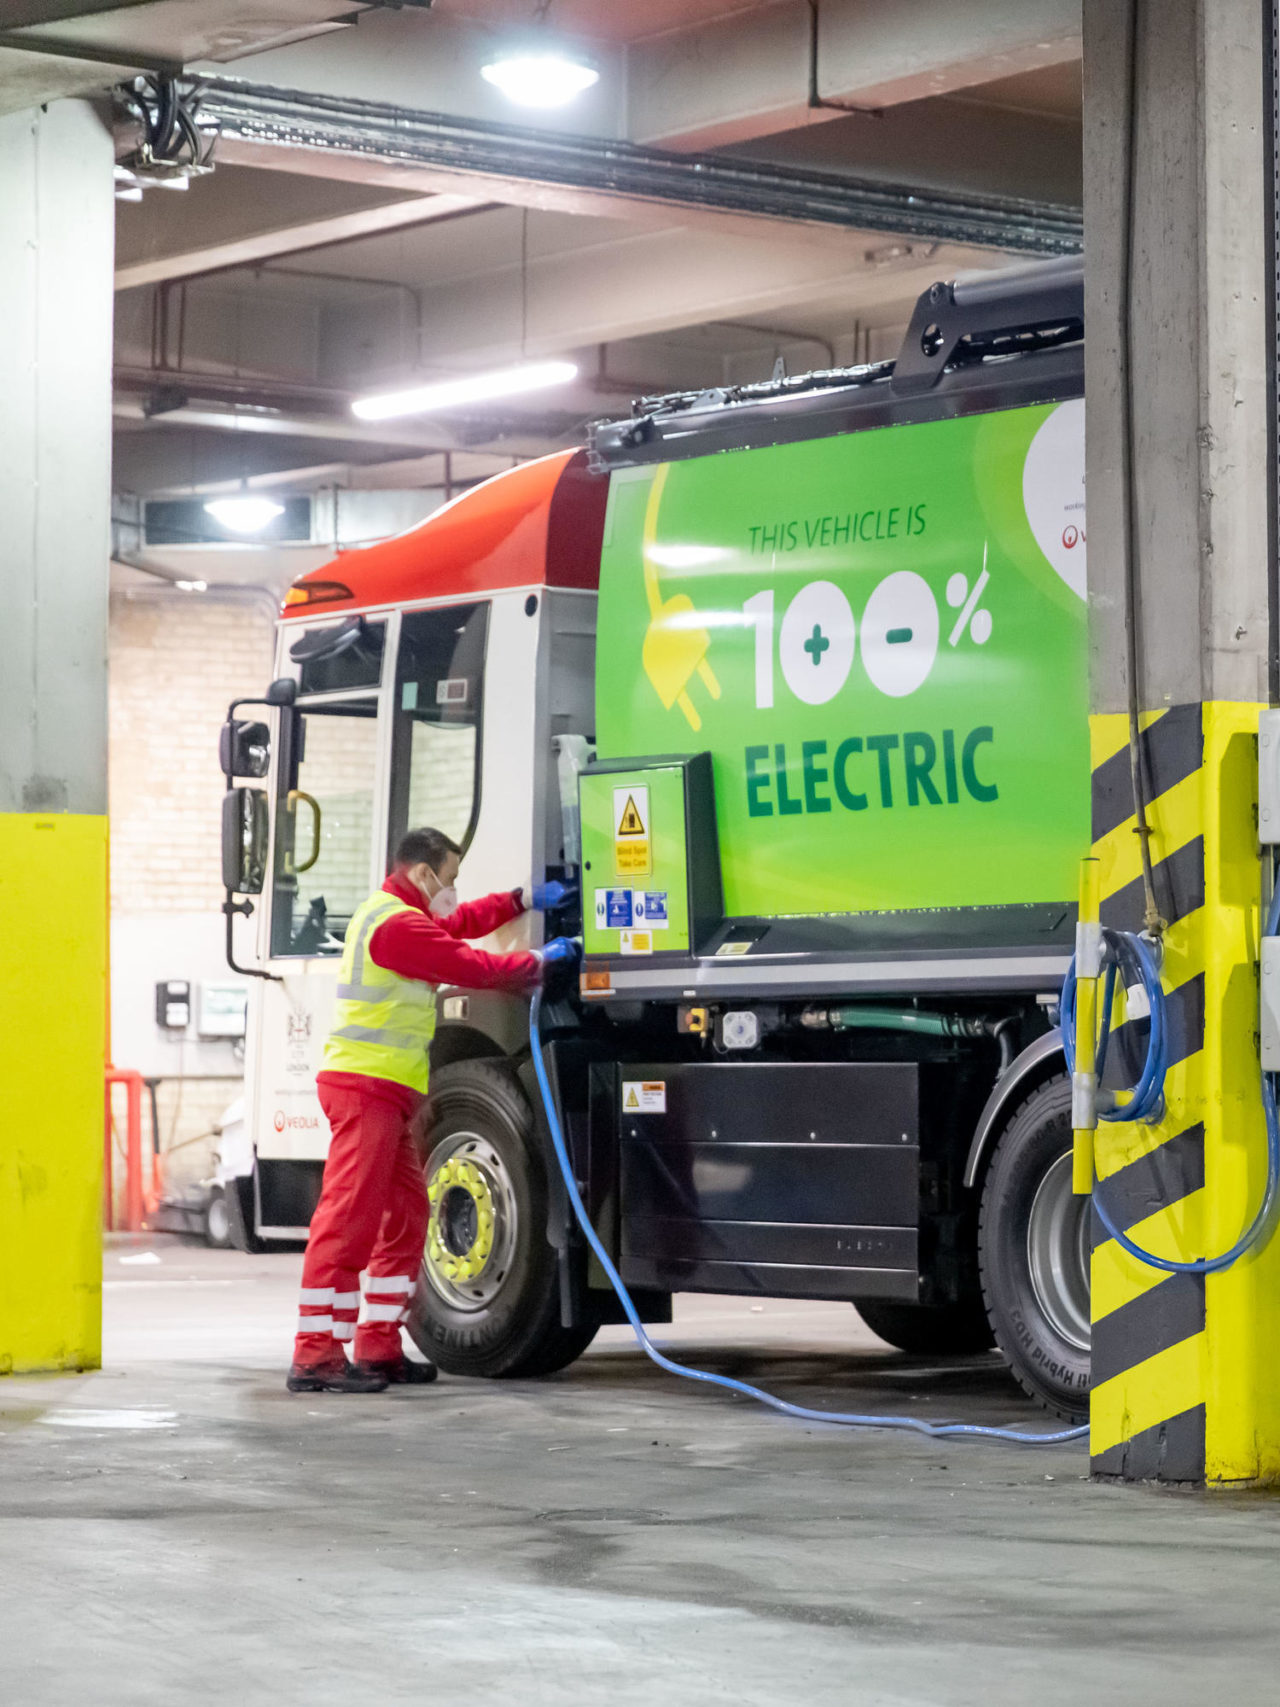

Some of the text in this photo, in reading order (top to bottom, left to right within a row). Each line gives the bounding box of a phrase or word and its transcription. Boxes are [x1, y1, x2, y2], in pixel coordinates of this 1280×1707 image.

[748, 504, 927, 555] THIS VEHICLE IS
[742, 568, 993, 710] 100%
[744, 725, 999, 818] ELECTRIC
[287, 1116, 320, 1129] VEOLIA
[1031, 1346, 1075, 1387] Hybrid
